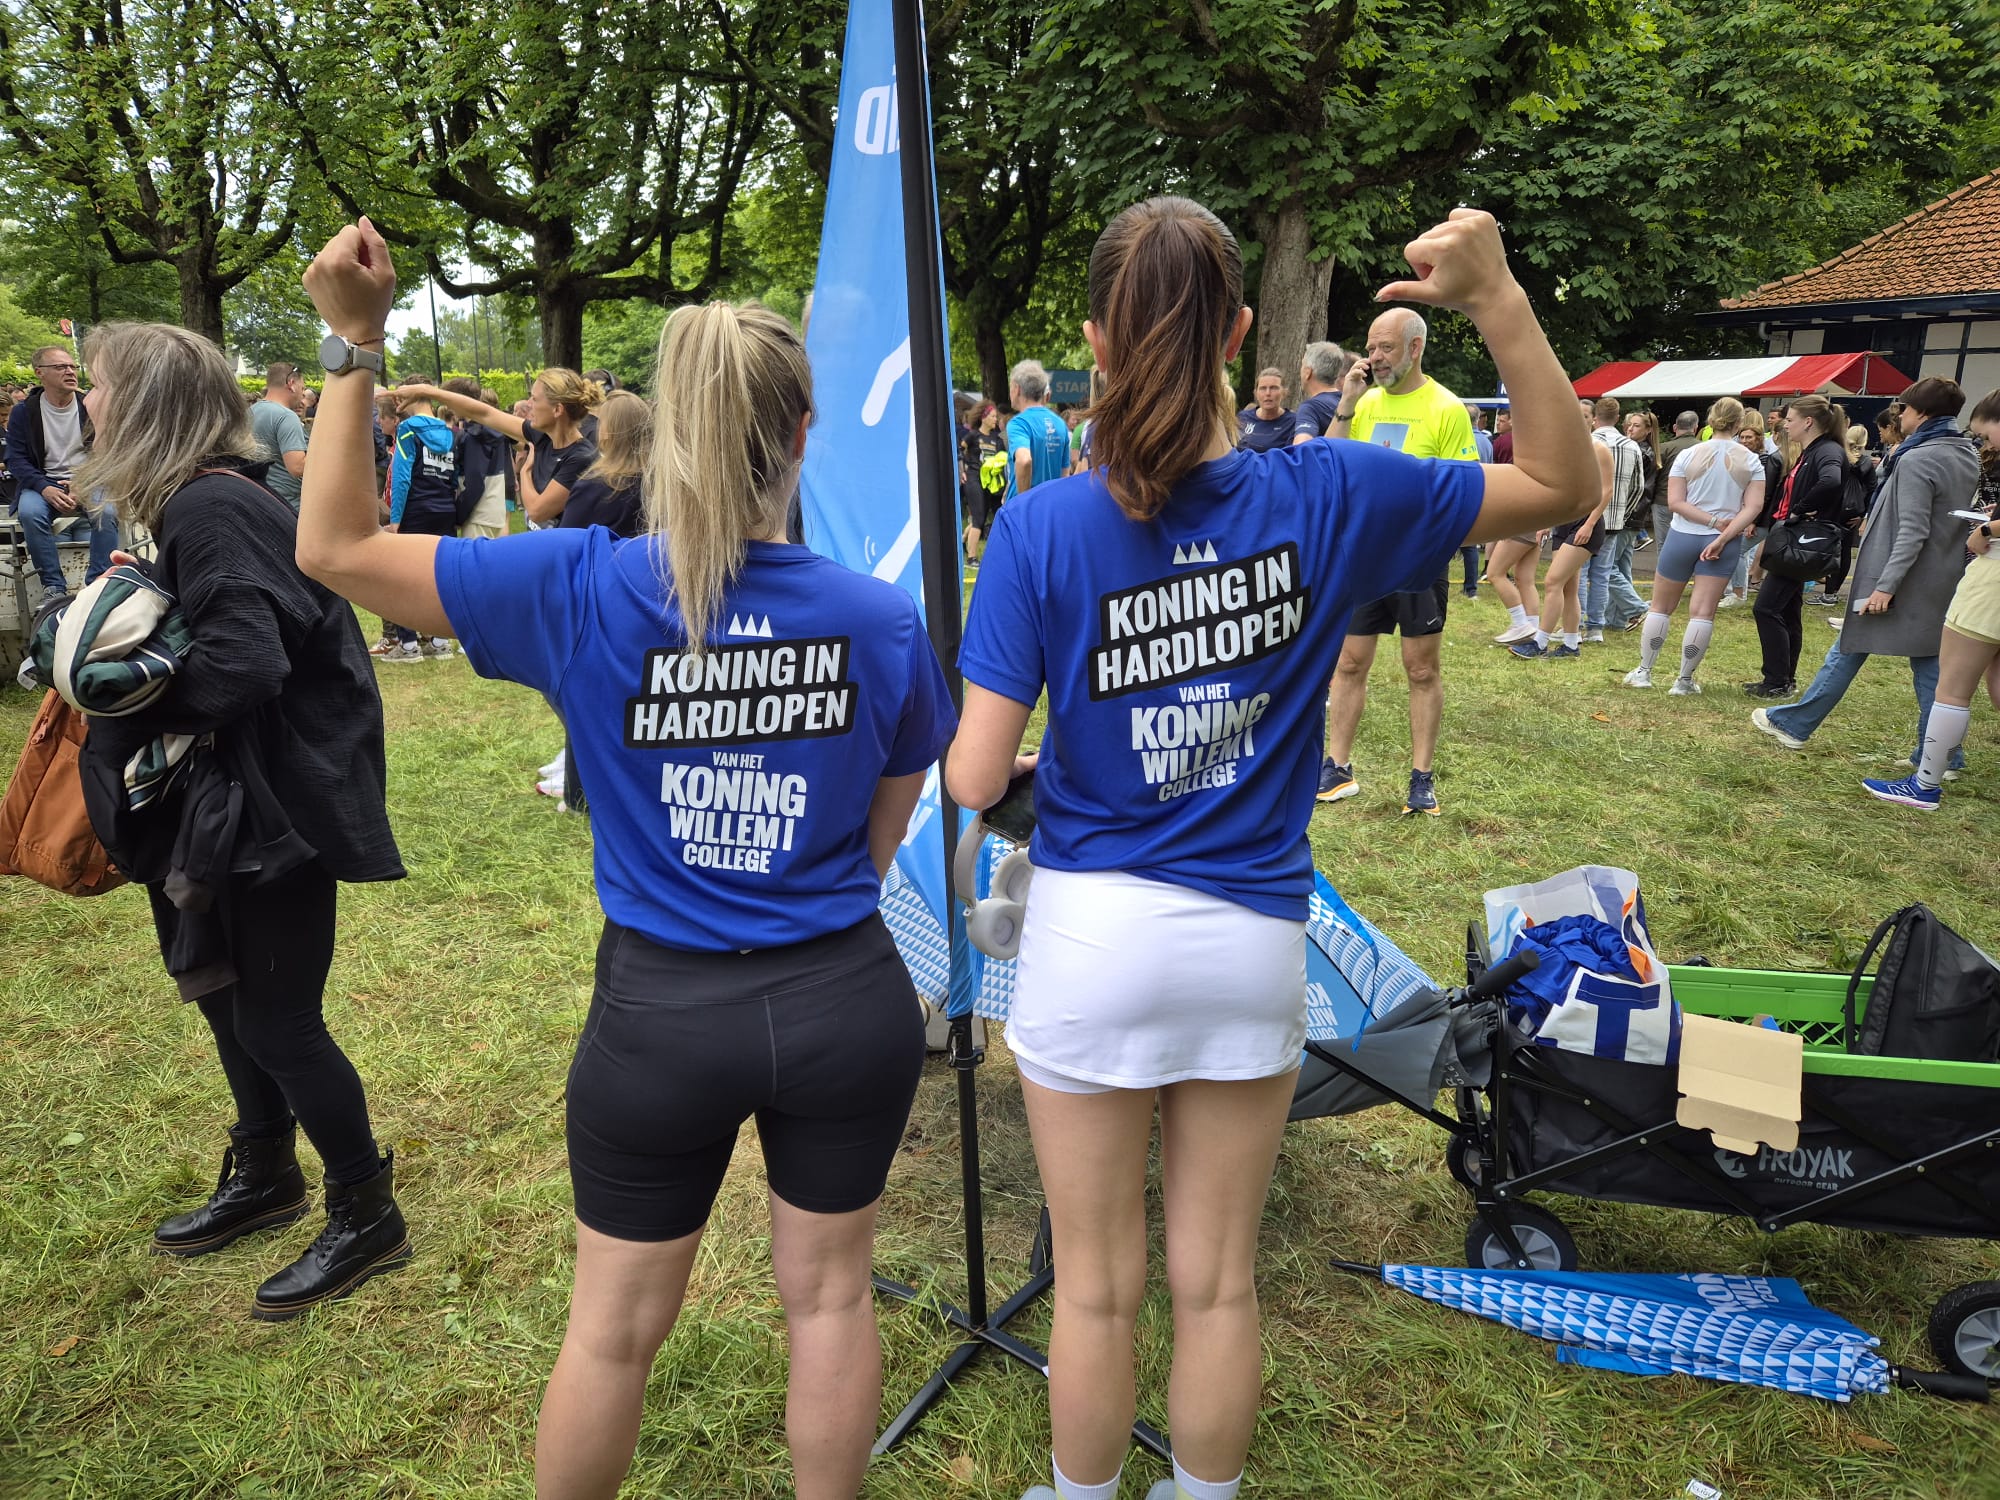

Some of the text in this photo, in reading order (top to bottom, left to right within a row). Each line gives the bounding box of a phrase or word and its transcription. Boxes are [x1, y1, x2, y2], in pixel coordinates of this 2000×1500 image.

[1109, 551, 1292, 641] KONING IN
[650, 643, 842, 695] KONING IN
[1097, 596, 1304, 692] HARDLOPEN
[633, 689, 849, 741] HARDLOPEN
[1178, 683, 1231, 703] VAN HET
[1131, 692, 1271, 751] KONING
[712, 751, 764, 769] VAN HET
[1141, 734, 1240, 784] WILLEM
[1158, 762, 1237, 802] COLLEGE
[660, 762, 808, 818] KONING
[669, 806, 795, 851] WILLEM I
[683, 843, 772, 874] COLLEGE
[1816, 1182, 1840, 1191] GEAR
